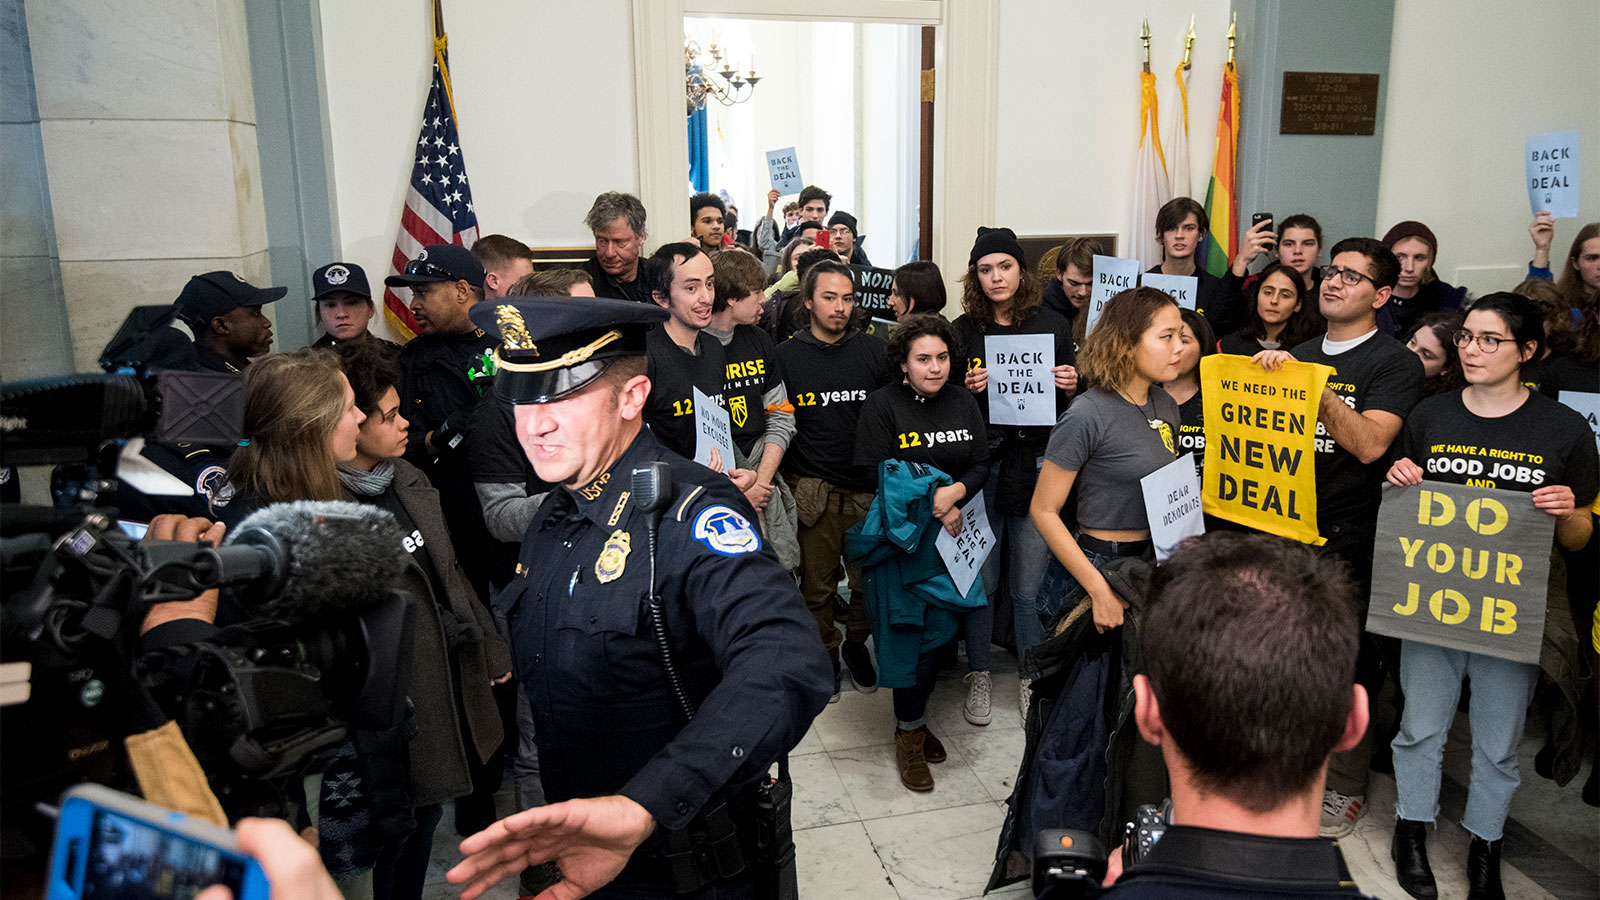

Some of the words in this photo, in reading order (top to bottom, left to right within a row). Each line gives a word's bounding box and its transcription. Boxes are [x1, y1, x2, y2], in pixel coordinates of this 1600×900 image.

[770, 156, 793, 166] BACK
[1532, 147, 1570, 162] BACK
[773, 171, 796, 181] DEAL
[1539, 163, 1561, 173] THE
[1532, 175, 1570, 189] DEAL
[861, 271, 893, 290] MOR
[1100, 273, 1130, 288] BACK
[1105, 289, 1120, 298] TH
[996, 352, 1043, 365] BACK
[726, 359, 766, 380] RISE
[1008, 369, 1033, 377] THE
[796, 392, 817, 407] 12
[820, 389, 867, 406] years
[997, 381, 1044, 394] DEAL
[1221, 379, 1238, 391] WE
[1243, 382, 1277, 397] NEED
[1282, 387, 1307, 401] THE
[1344, 384, 1356, 393] TO
[672, 398, 693, 417] 12
[700, 406, 710, 421] NO
[711, 413, 728, 435] MORE
[1221, 402, 1305, 436] GREEN
[702, 422, 729, 450] EXCUSES
[898, 431, 922, 449] 12
[924, 428, 973, 448] years.
[1220, 434, 1303, 477] NEW
[1431, 444, 1445, 454] WE
[1446, 444, 1477, 456] HAVE
[1478, 447, 1487, 457] A
[1489, 449, 1526, 462] RIGHT
[1527, 454, 1544, 465] TO
[1427, 457, 1484, 475] GOOD
[1488, 462, 1546, 485] JOBS
[1465, 478, 1496, 489] AND
[1167, 485, 1189, 504] DEAR
[1218, 472, 1301, 521] DEAL
[1162, 496, 1200, 526] DEMOCRATS
[1417, 490, 1509, 535] DO
[962, 526, 976, 550] THE
[966, 508, 987, 549] BACK
[953, 534, 975, 569] EAL
[1399, 536, 1523, 585] YOUR
[1392, 582, 1518, 635] JOB
